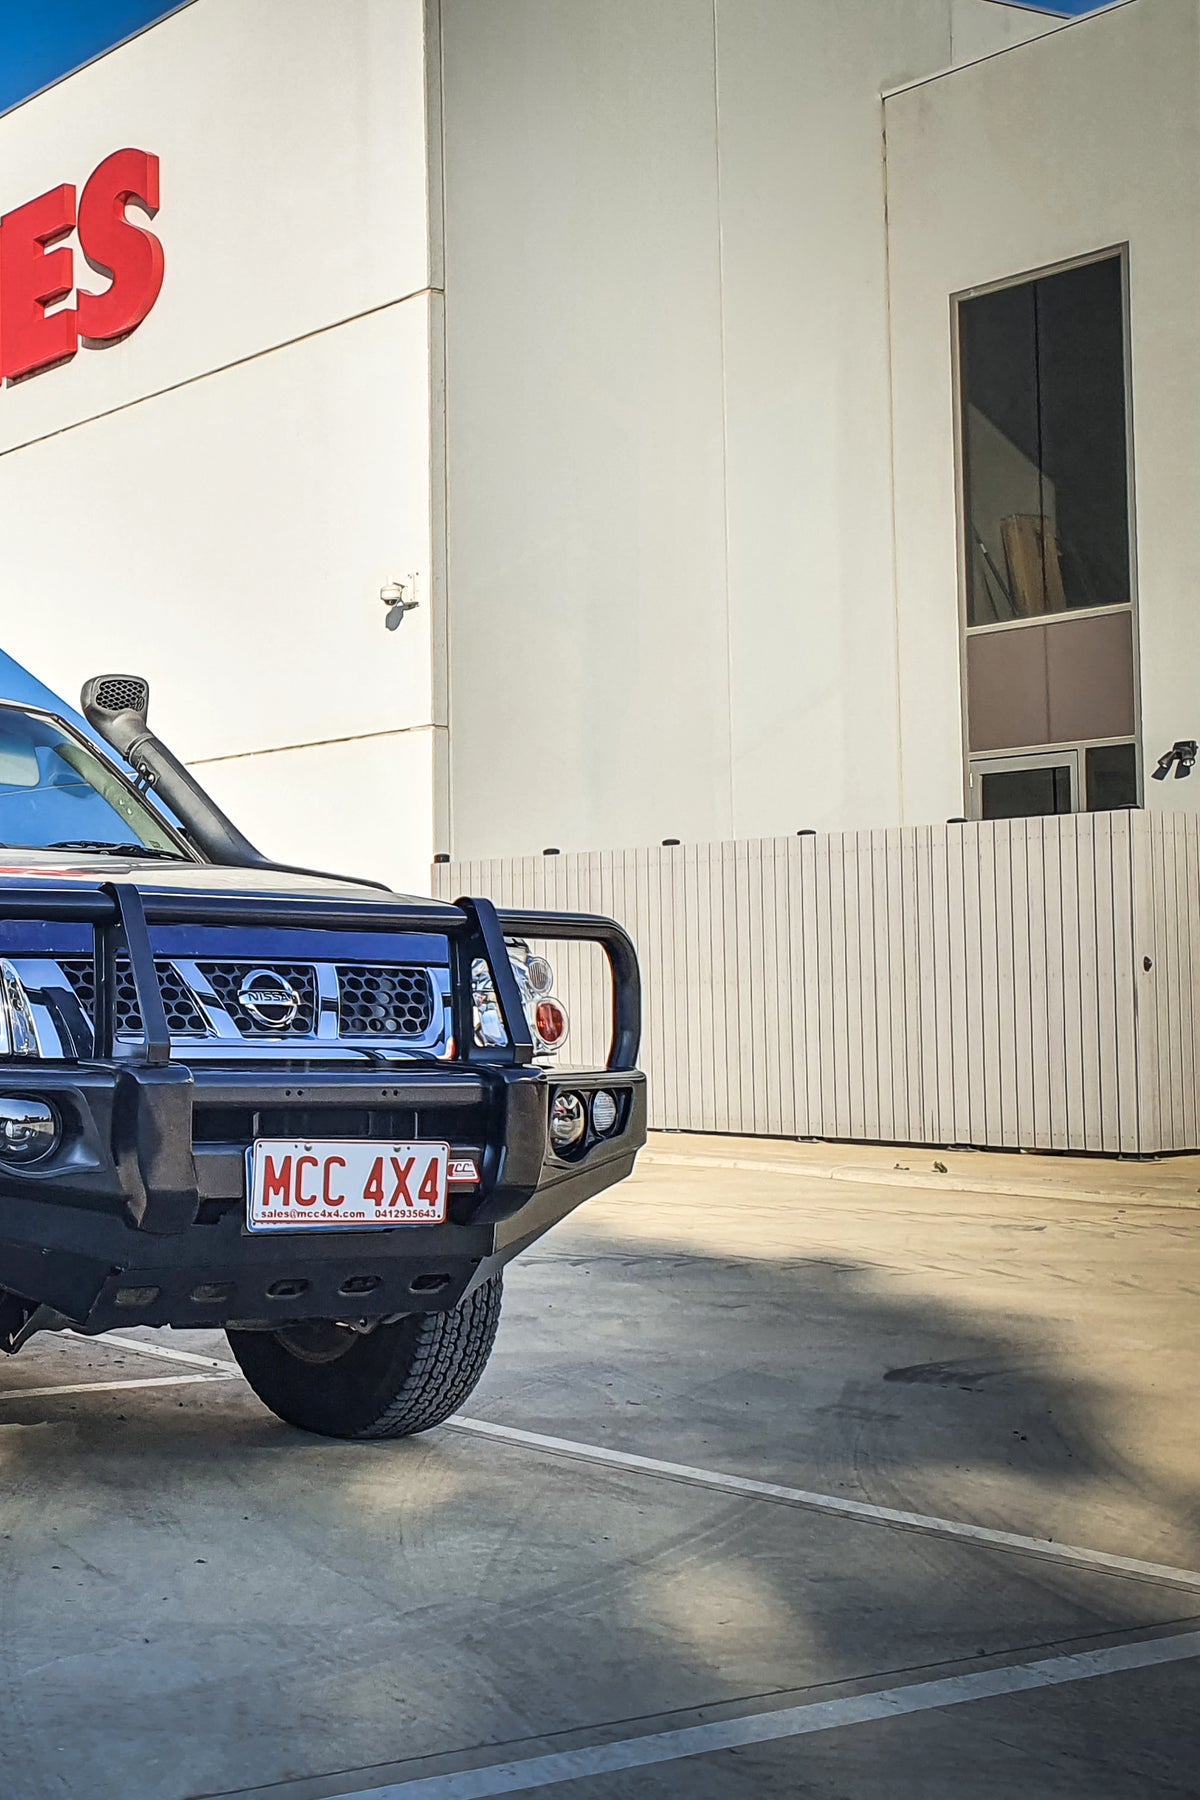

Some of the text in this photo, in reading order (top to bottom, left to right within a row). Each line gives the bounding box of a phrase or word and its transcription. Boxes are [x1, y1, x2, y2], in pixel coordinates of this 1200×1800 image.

[262, 1155, 438, 1206] MCC 4X4
[261, 1208, 436, 1219] sales@mcc4x4.com 0412935643
